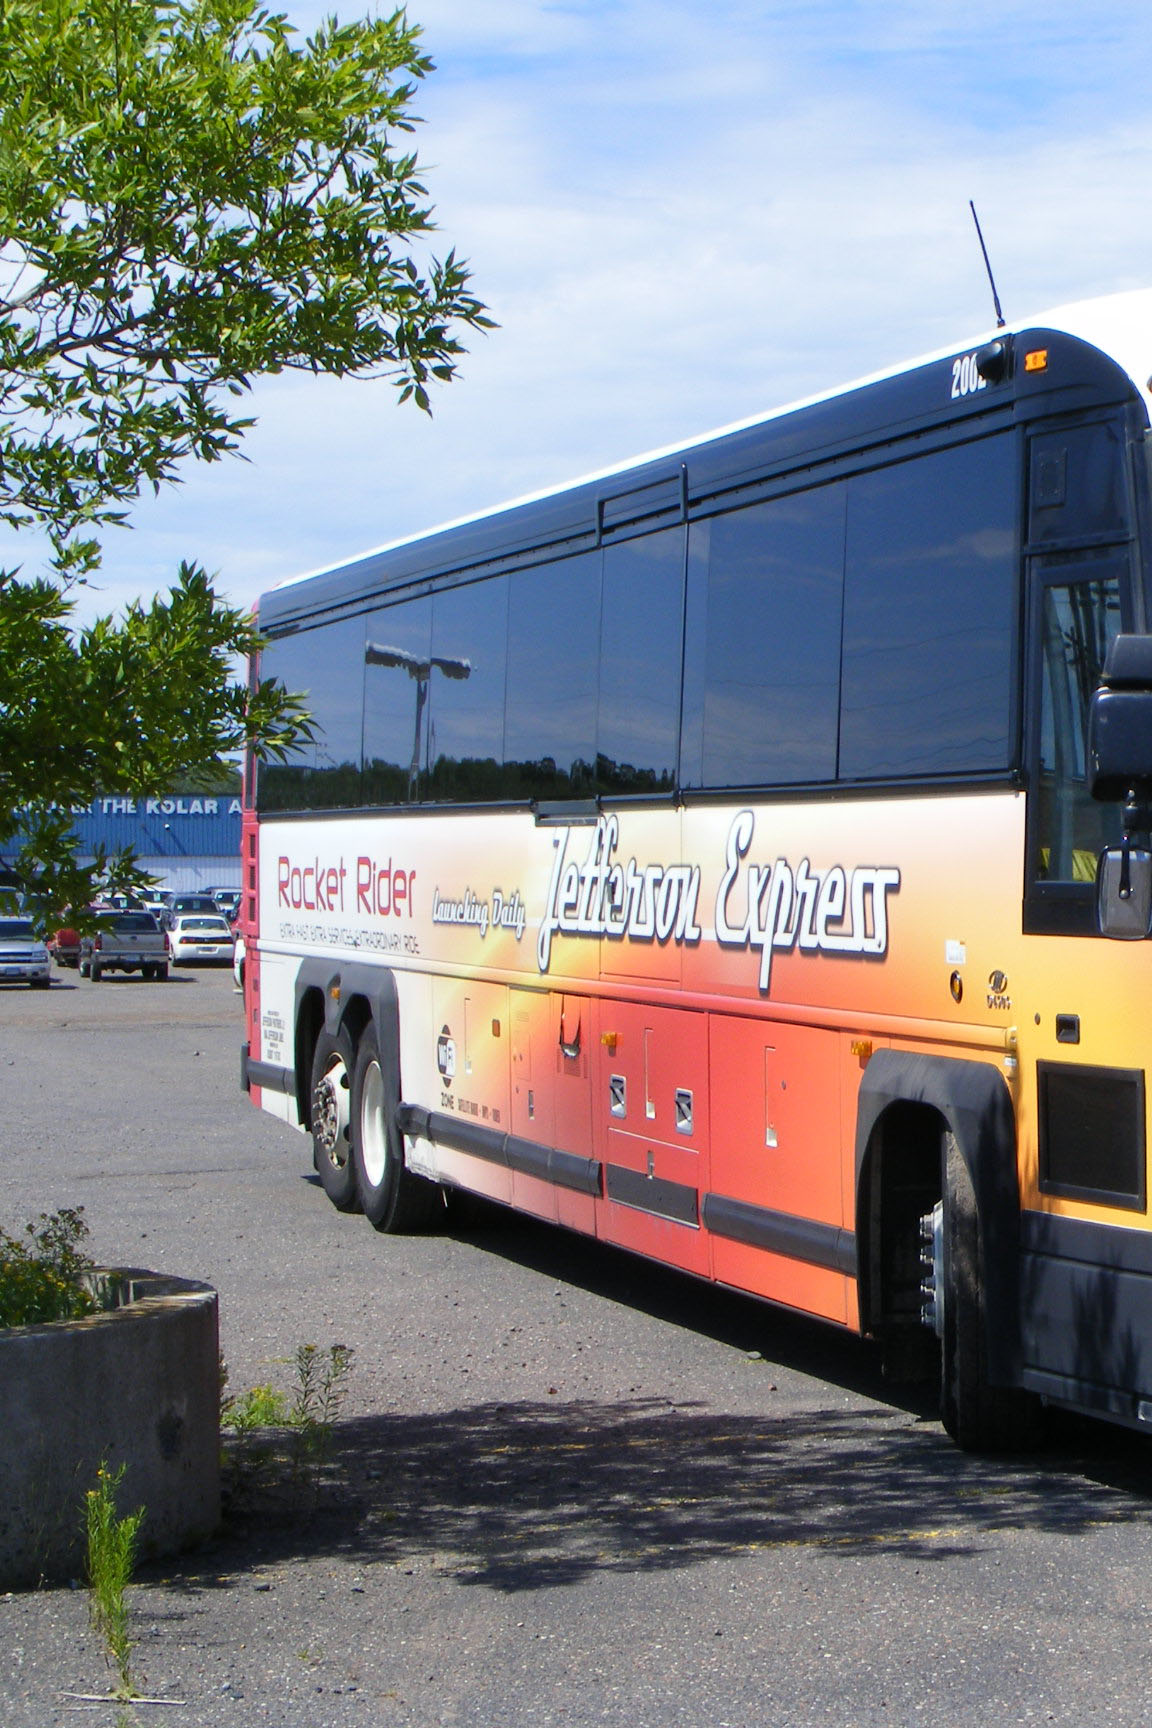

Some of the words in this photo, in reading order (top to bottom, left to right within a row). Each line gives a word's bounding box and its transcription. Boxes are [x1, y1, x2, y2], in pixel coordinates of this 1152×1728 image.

[101, 800, 137, 814] THE
[146, 799, 218, 814] KOLAR
[278, 856, 347, 912] Rocket
[357, 856, 416, 918] Rider
[433, 885, 488, 938] Launching
[492, 887, 526, 941] Daily
[537, 813, 702, 972] Jefferson
[715, 809, 900, 994] Express
